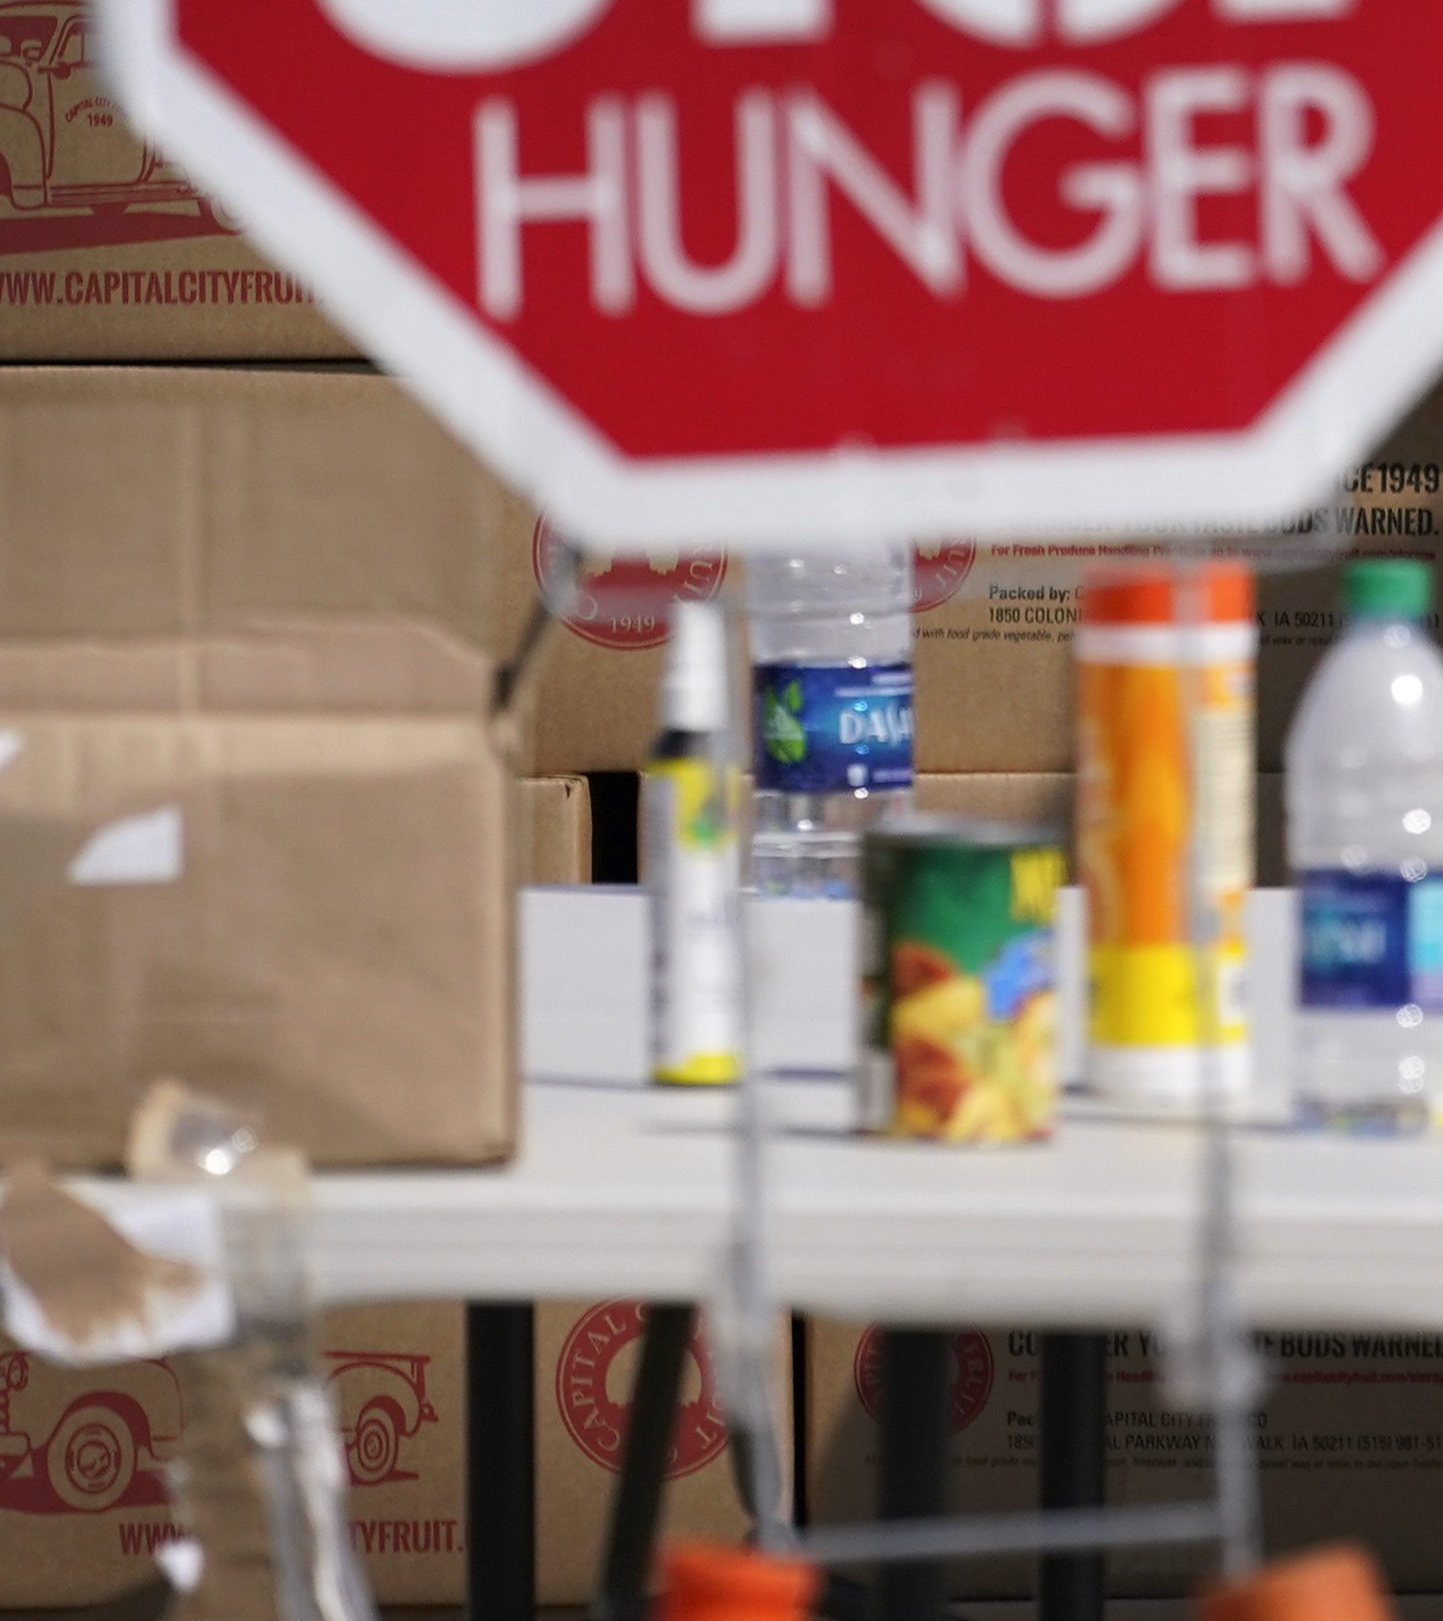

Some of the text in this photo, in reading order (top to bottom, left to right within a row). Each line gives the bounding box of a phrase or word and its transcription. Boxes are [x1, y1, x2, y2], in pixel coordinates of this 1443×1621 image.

[88, 114, 113, 127] 1949
[475, 63, 1385, 316] HUNGER
[1379, 462, 1440, 494] 1949
[1335, 506, 1440, 537] WARNED.
[991, 544, 1010, 556] For
[1013, 544, 1045, 556] Fresh
[1048, 544, 1095, 556] Produce
[990, 584, 1070, 603] Packed by:
[610, 616, 655, 634] 1949
[990, 607, 1020, 624] 1850
[1274, 611, 1290, 627] IA
[1294, 611, 1334, 627] 50211
[922, 628, 944, 639] with
[947, 627, 969, 639] food
[972, 628, 1000, 641] grade
[570, 1315, 626, 1451] CAPITAL
[1125, 1434, 1200, 1450] PARKWAY
[1293, 1434, 1308, 1451] IA
[1312, 1434, 1351, 1451] 50211
